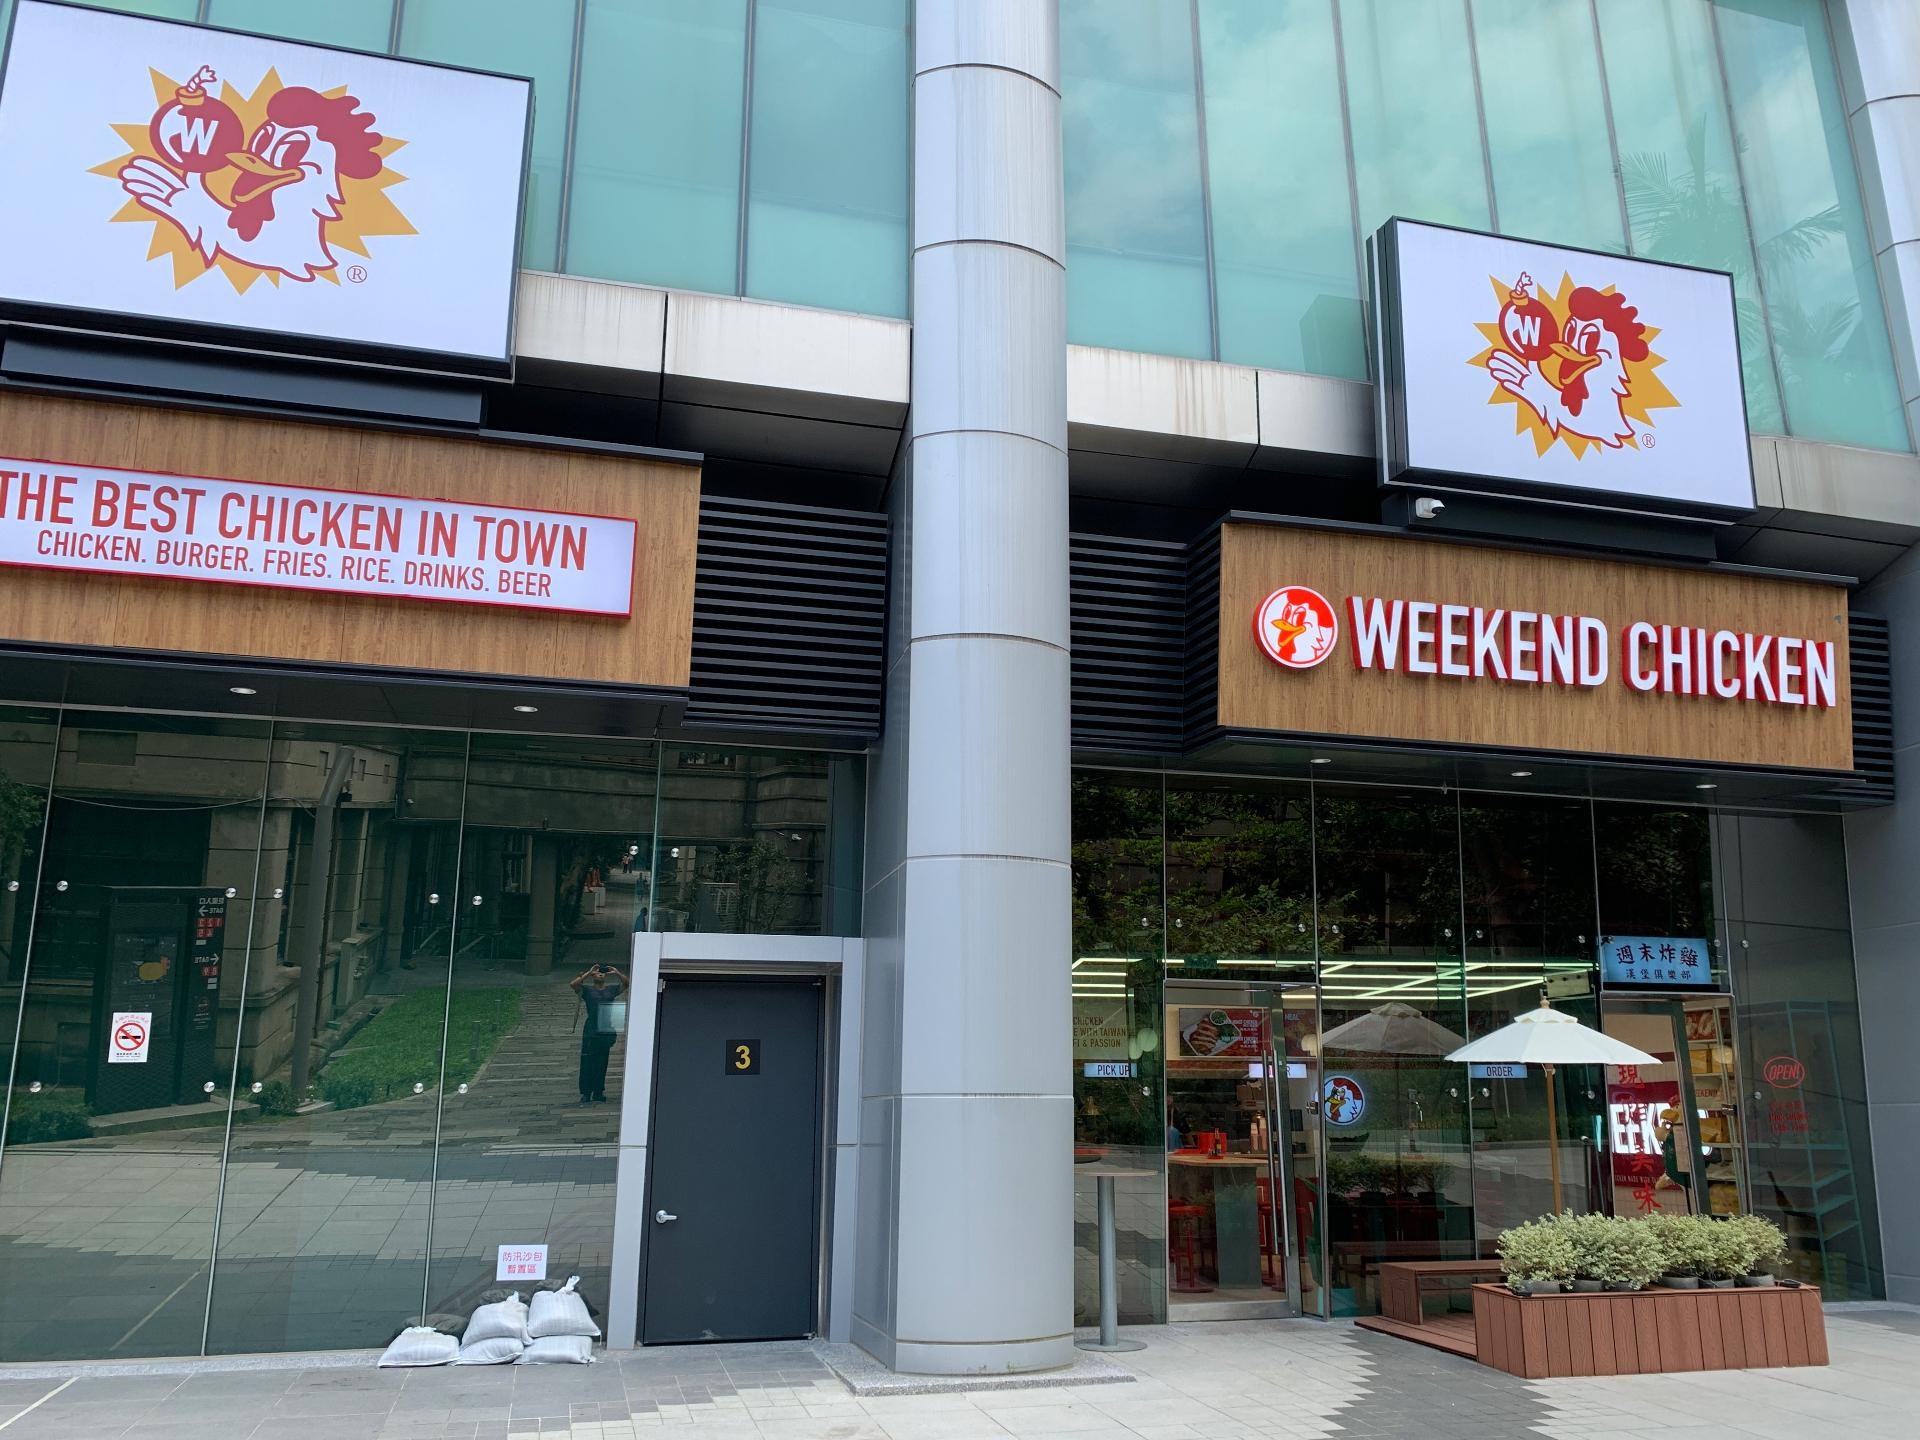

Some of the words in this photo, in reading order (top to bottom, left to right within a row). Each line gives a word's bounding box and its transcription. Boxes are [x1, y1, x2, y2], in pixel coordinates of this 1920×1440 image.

[179, 115, 220, 156] W
[1518, 315, 1542, 347] W
[0, 471, 78, 525] THE
[91, 479, 207, 536] BEST
[217, 491, 403, 553] CHICKEN
[417, 510, 460, 559] IN
[472, 515, 588, 571] TOWN
[37, 529, 147, 563] CHICKEN.
[155, 540, 254, 572] BURGER.
[262, 549, 332, 579] FRIES.
[340, 555, 395, 584] RICE.
[403, 561, 490, 592] DRINKS.
[497, 570, 552, 598] BEER
[1346, 595, 1609, 687] WEEKEND
[1623, 621, 1837, 709] CHICKEN
[1615, 943, 1699, 968] 週末炸雞
[1625, 968, 1692, 981] 漢堡俱樂部
[1073, 1016, 1104, 1026] CHICKEN
[1080, 1028, 1098, 1037] WITH
[1100, 1028, 1126, 1037] TAIWAN
[1082, 1039, 1088, 1048] &
[1090, 1039, 1121, 1048] PASSION
[735, 1045, 751, 1069] 3
[1097, 1064, 1117, 1076] PICK
[1119, 1064, 1130, 1076] UP
[1486, 1066, 1514, 1077] ORDER
[502, 1251, 543, 1263] 防汛沙包
